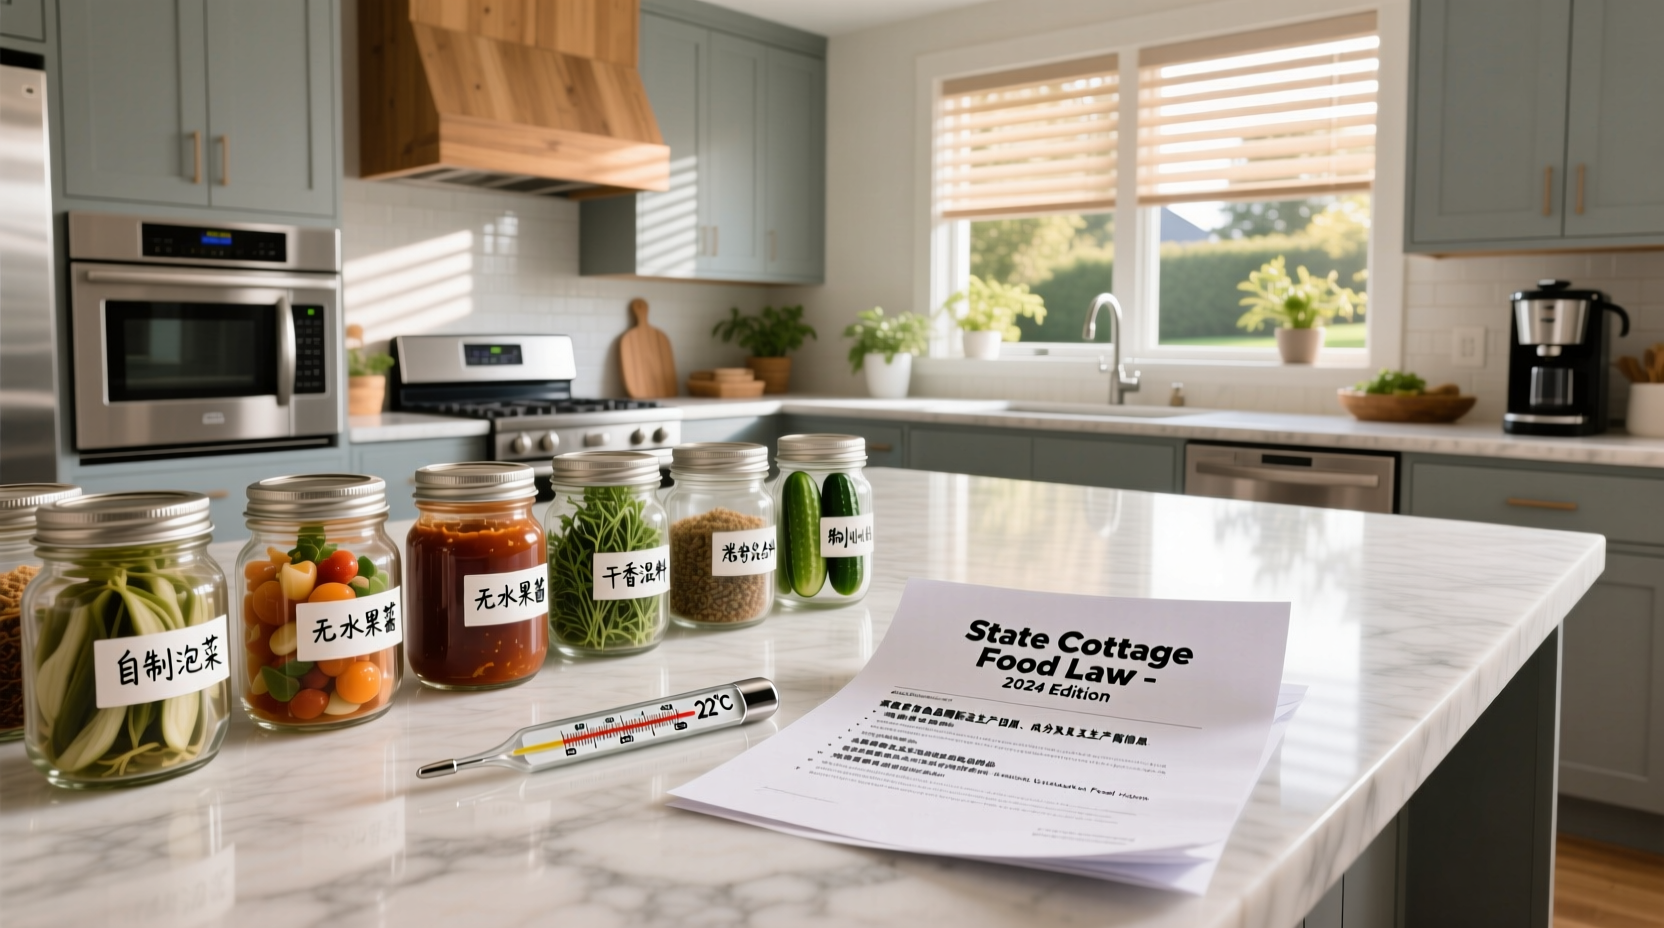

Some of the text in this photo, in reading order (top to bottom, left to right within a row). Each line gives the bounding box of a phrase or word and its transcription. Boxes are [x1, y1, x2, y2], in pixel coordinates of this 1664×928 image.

[118, 634, 222, 686] 自制泡菜
[965, 619, 1194, 669] State Cottage
[976, 646, 1061, 677] Food
[1065, 658, 1138, 686] Law
[1001, 676, 1111, 703] 2024 Edition
